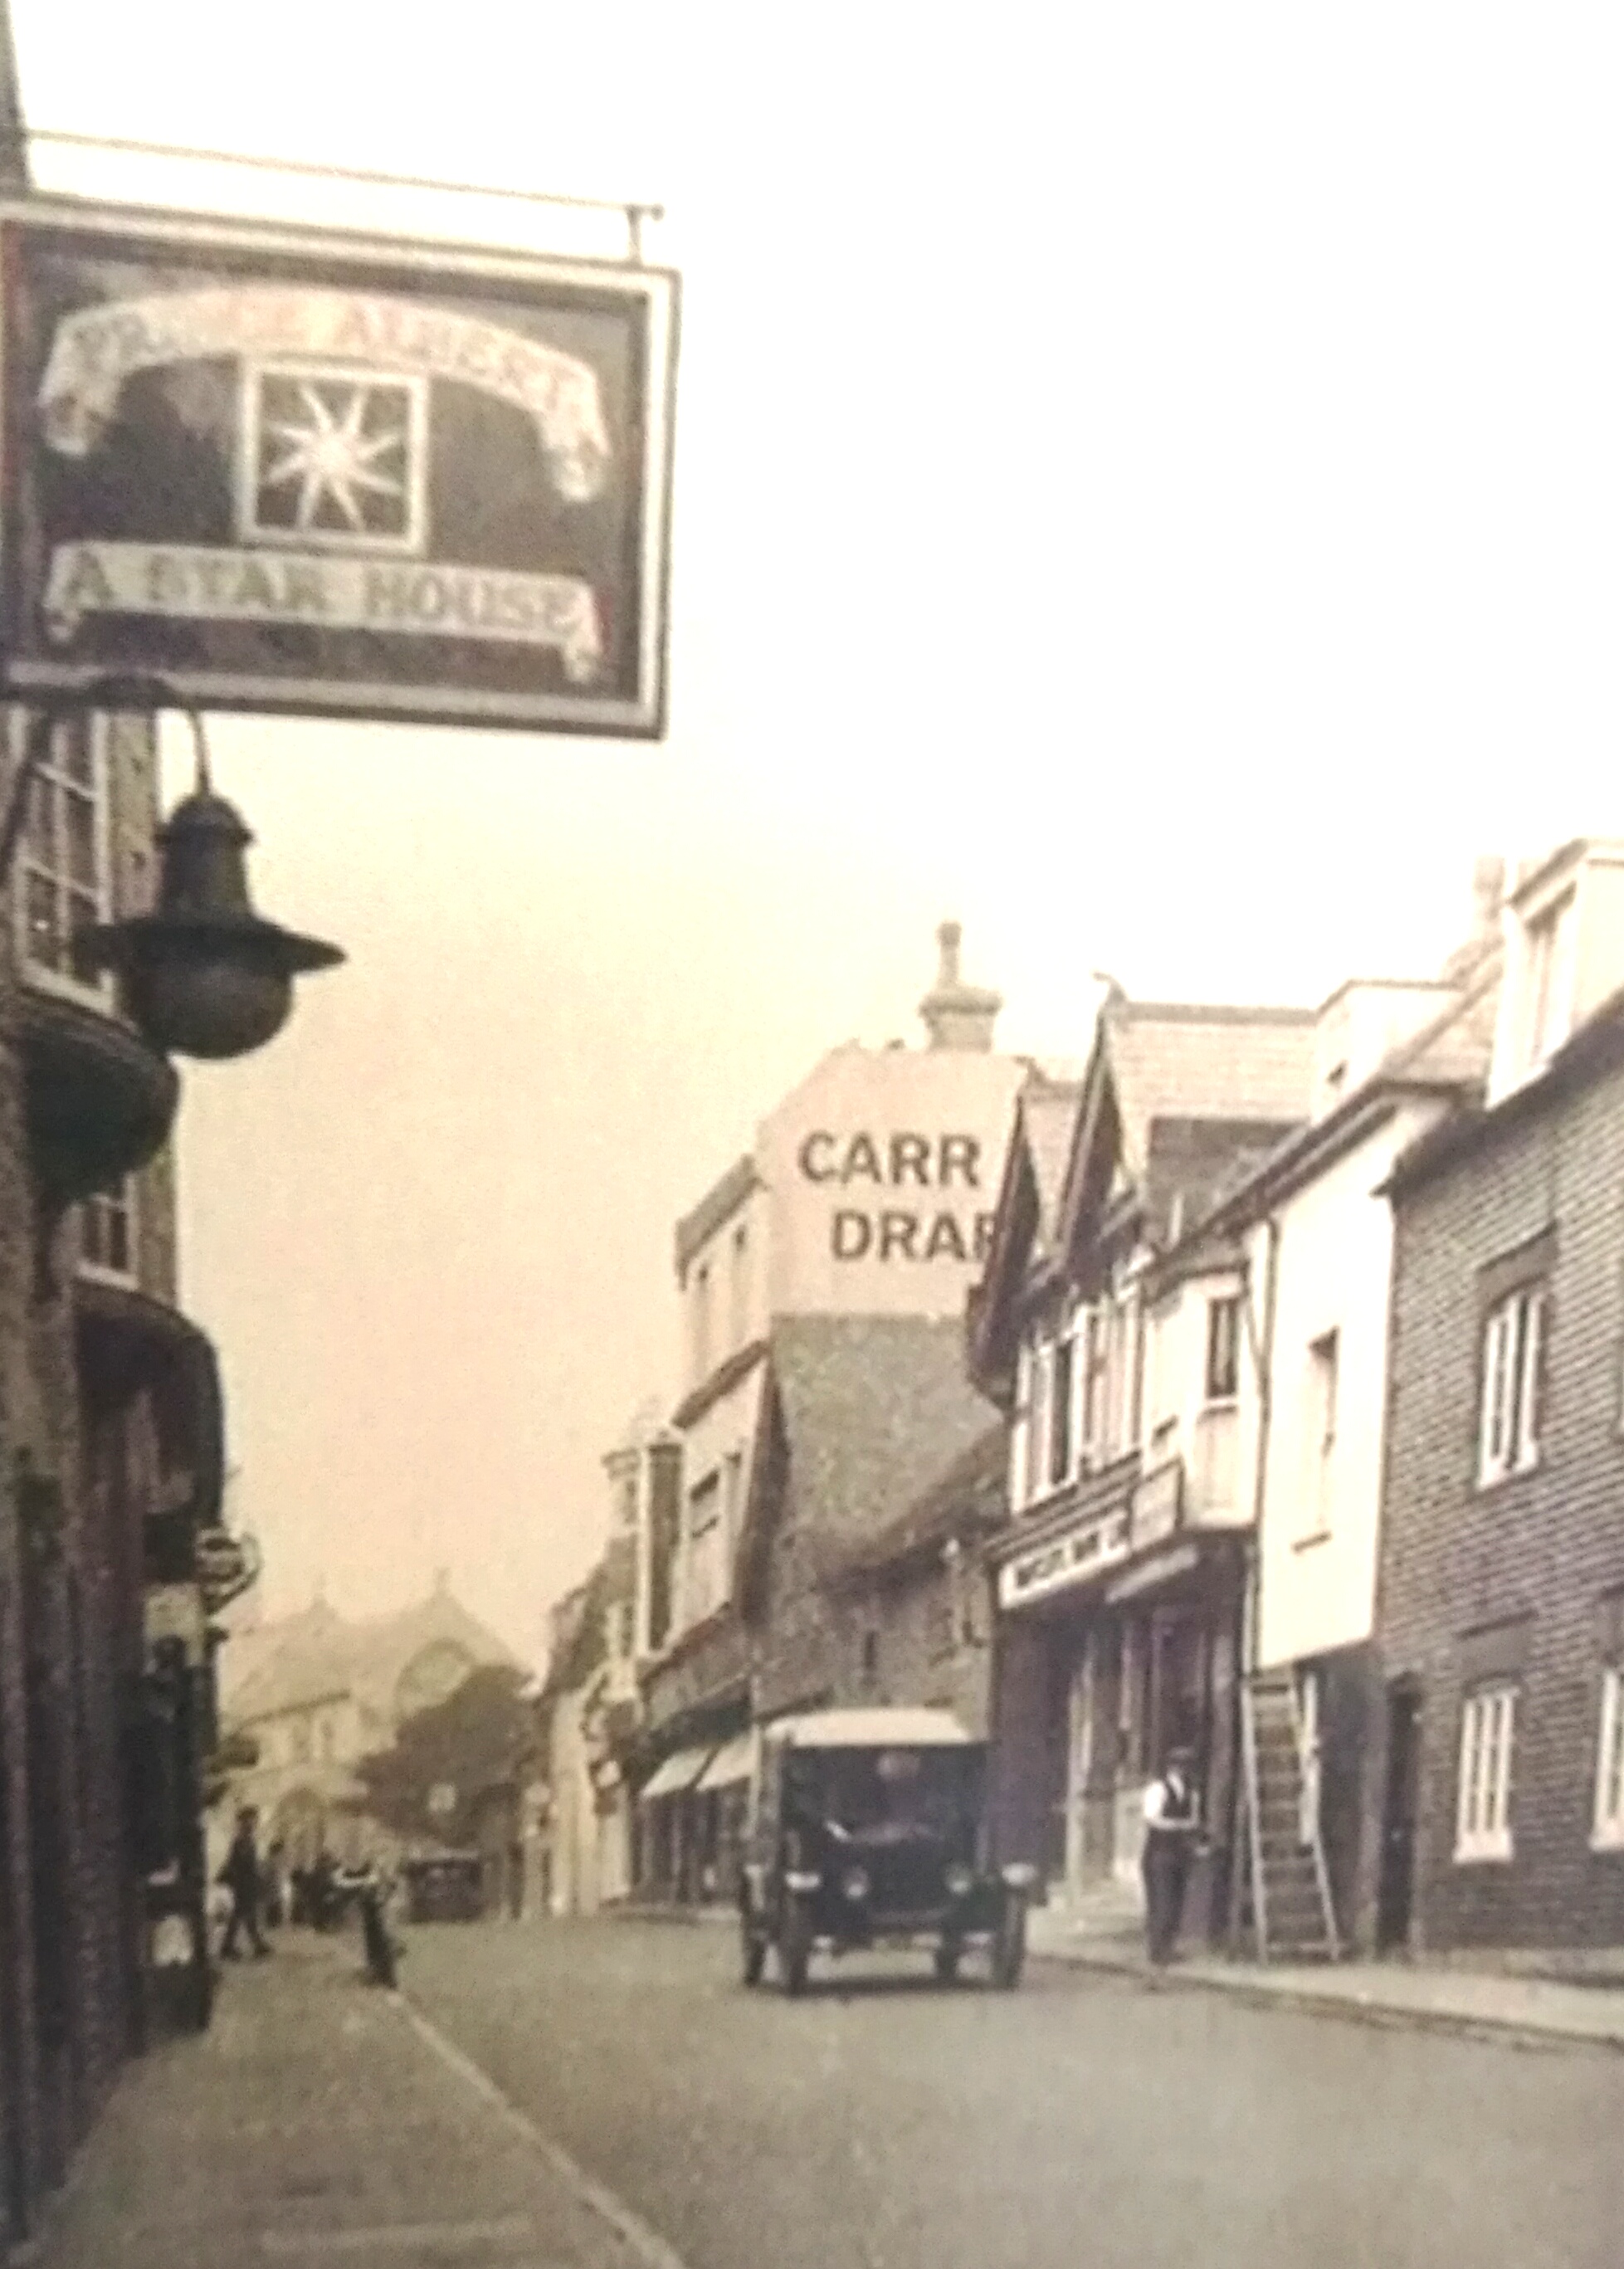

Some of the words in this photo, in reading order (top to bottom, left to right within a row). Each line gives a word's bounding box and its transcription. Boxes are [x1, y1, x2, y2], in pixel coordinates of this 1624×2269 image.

[70, 550, 110, 608] A
[365, 568, 579, 635] HOUSE
[798, 1130, 980, 1185] CARR
